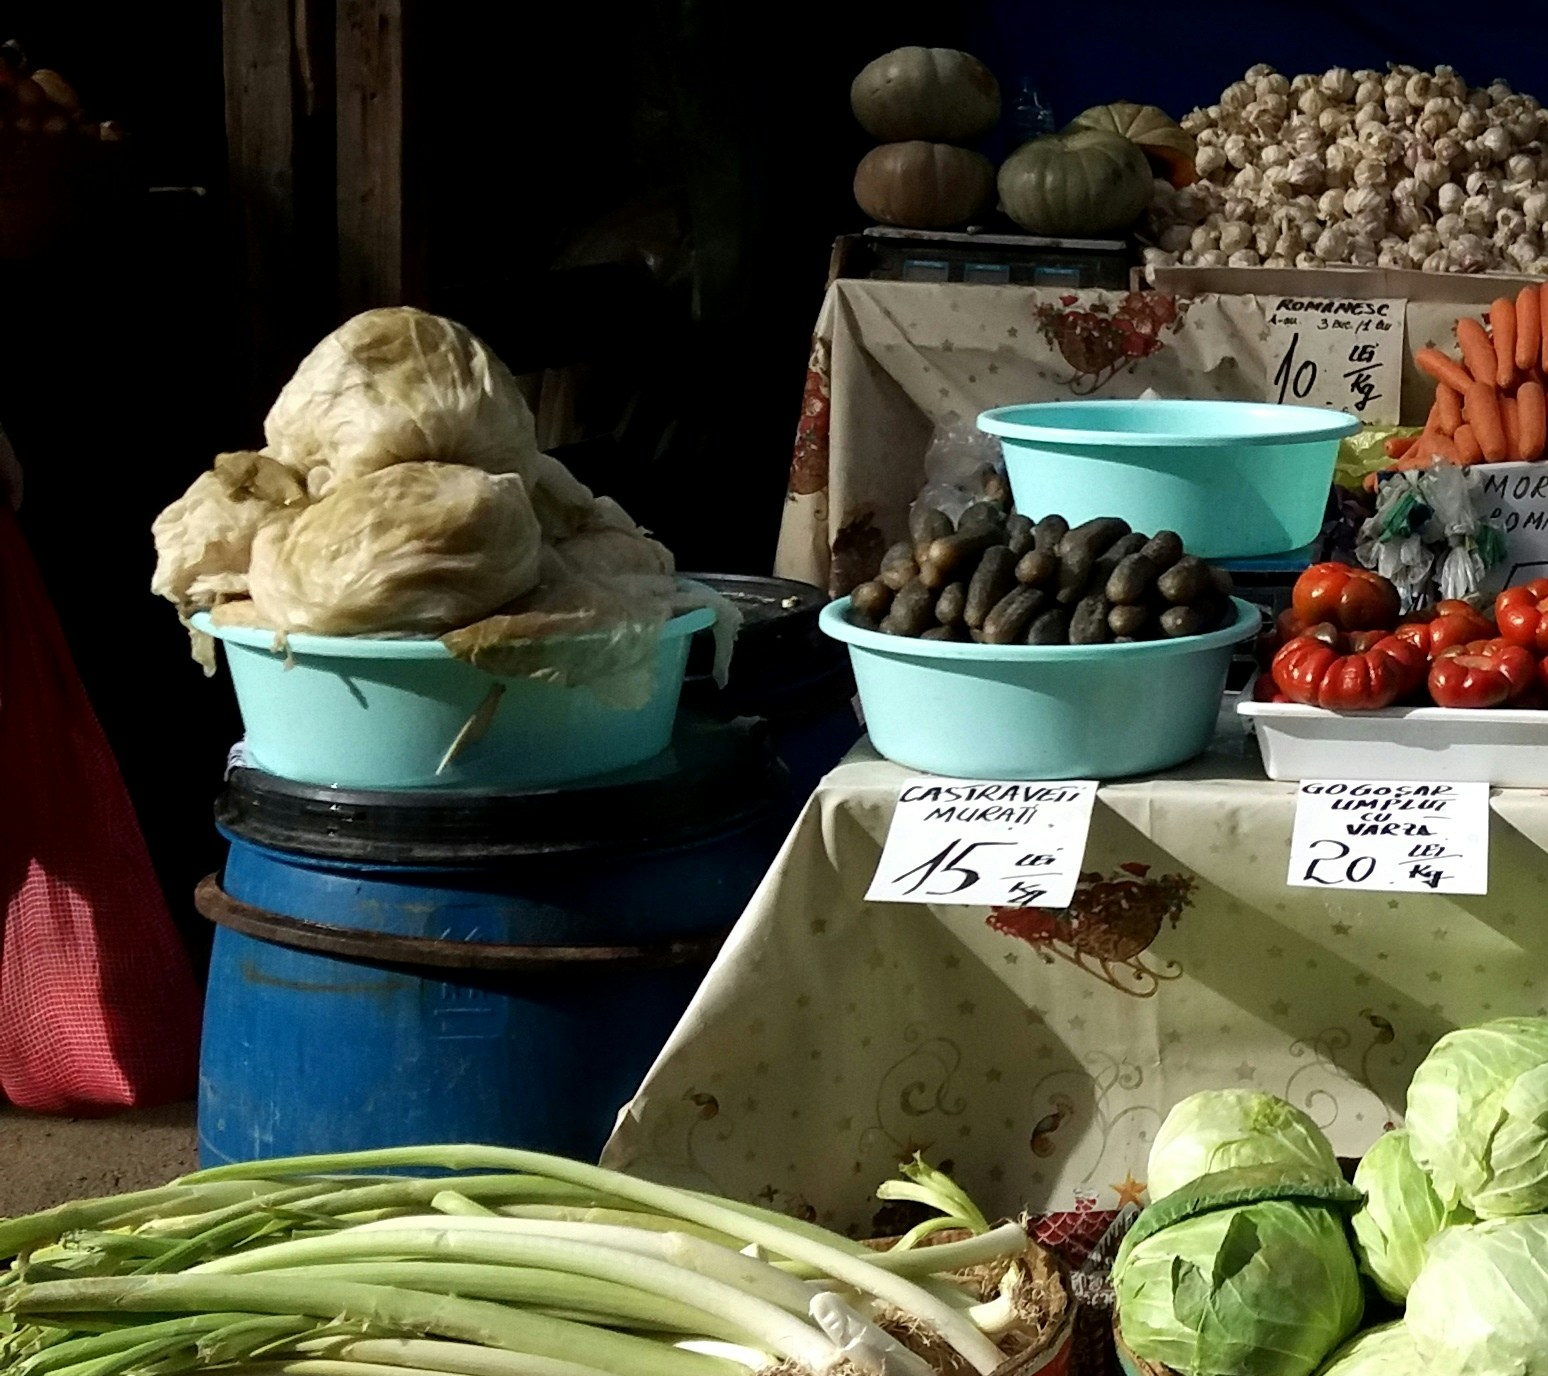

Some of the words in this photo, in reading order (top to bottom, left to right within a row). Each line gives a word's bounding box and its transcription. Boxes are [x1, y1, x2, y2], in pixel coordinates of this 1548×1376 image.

[1274, 332, 1318, 405] 10
[1360, 812, 1393, 822] CU
[892, 838, 1019, 896] 15
